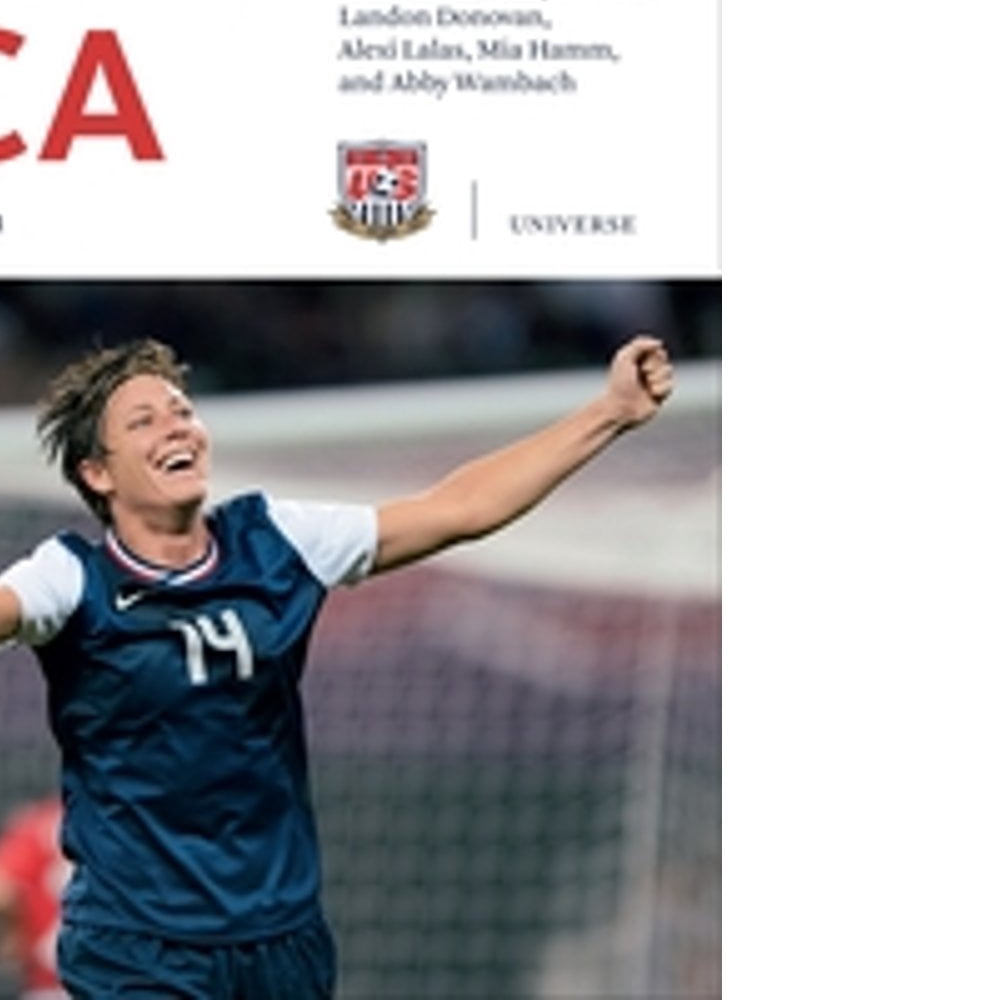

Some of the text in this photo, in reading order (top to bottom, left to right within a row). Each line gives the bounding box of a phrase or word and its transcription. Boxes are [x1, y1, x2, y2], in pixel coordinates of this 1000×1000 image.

[340, 5, 551, 30] Landon Donovan,
[338, 38, 620, 63] Alexi Lalas, Mia Hamm,
[338, 70, 577, 99] and Abby Wambach
[510, 215, 635, 234] UNIVERSE
[169, 608, 253, 686] 14
